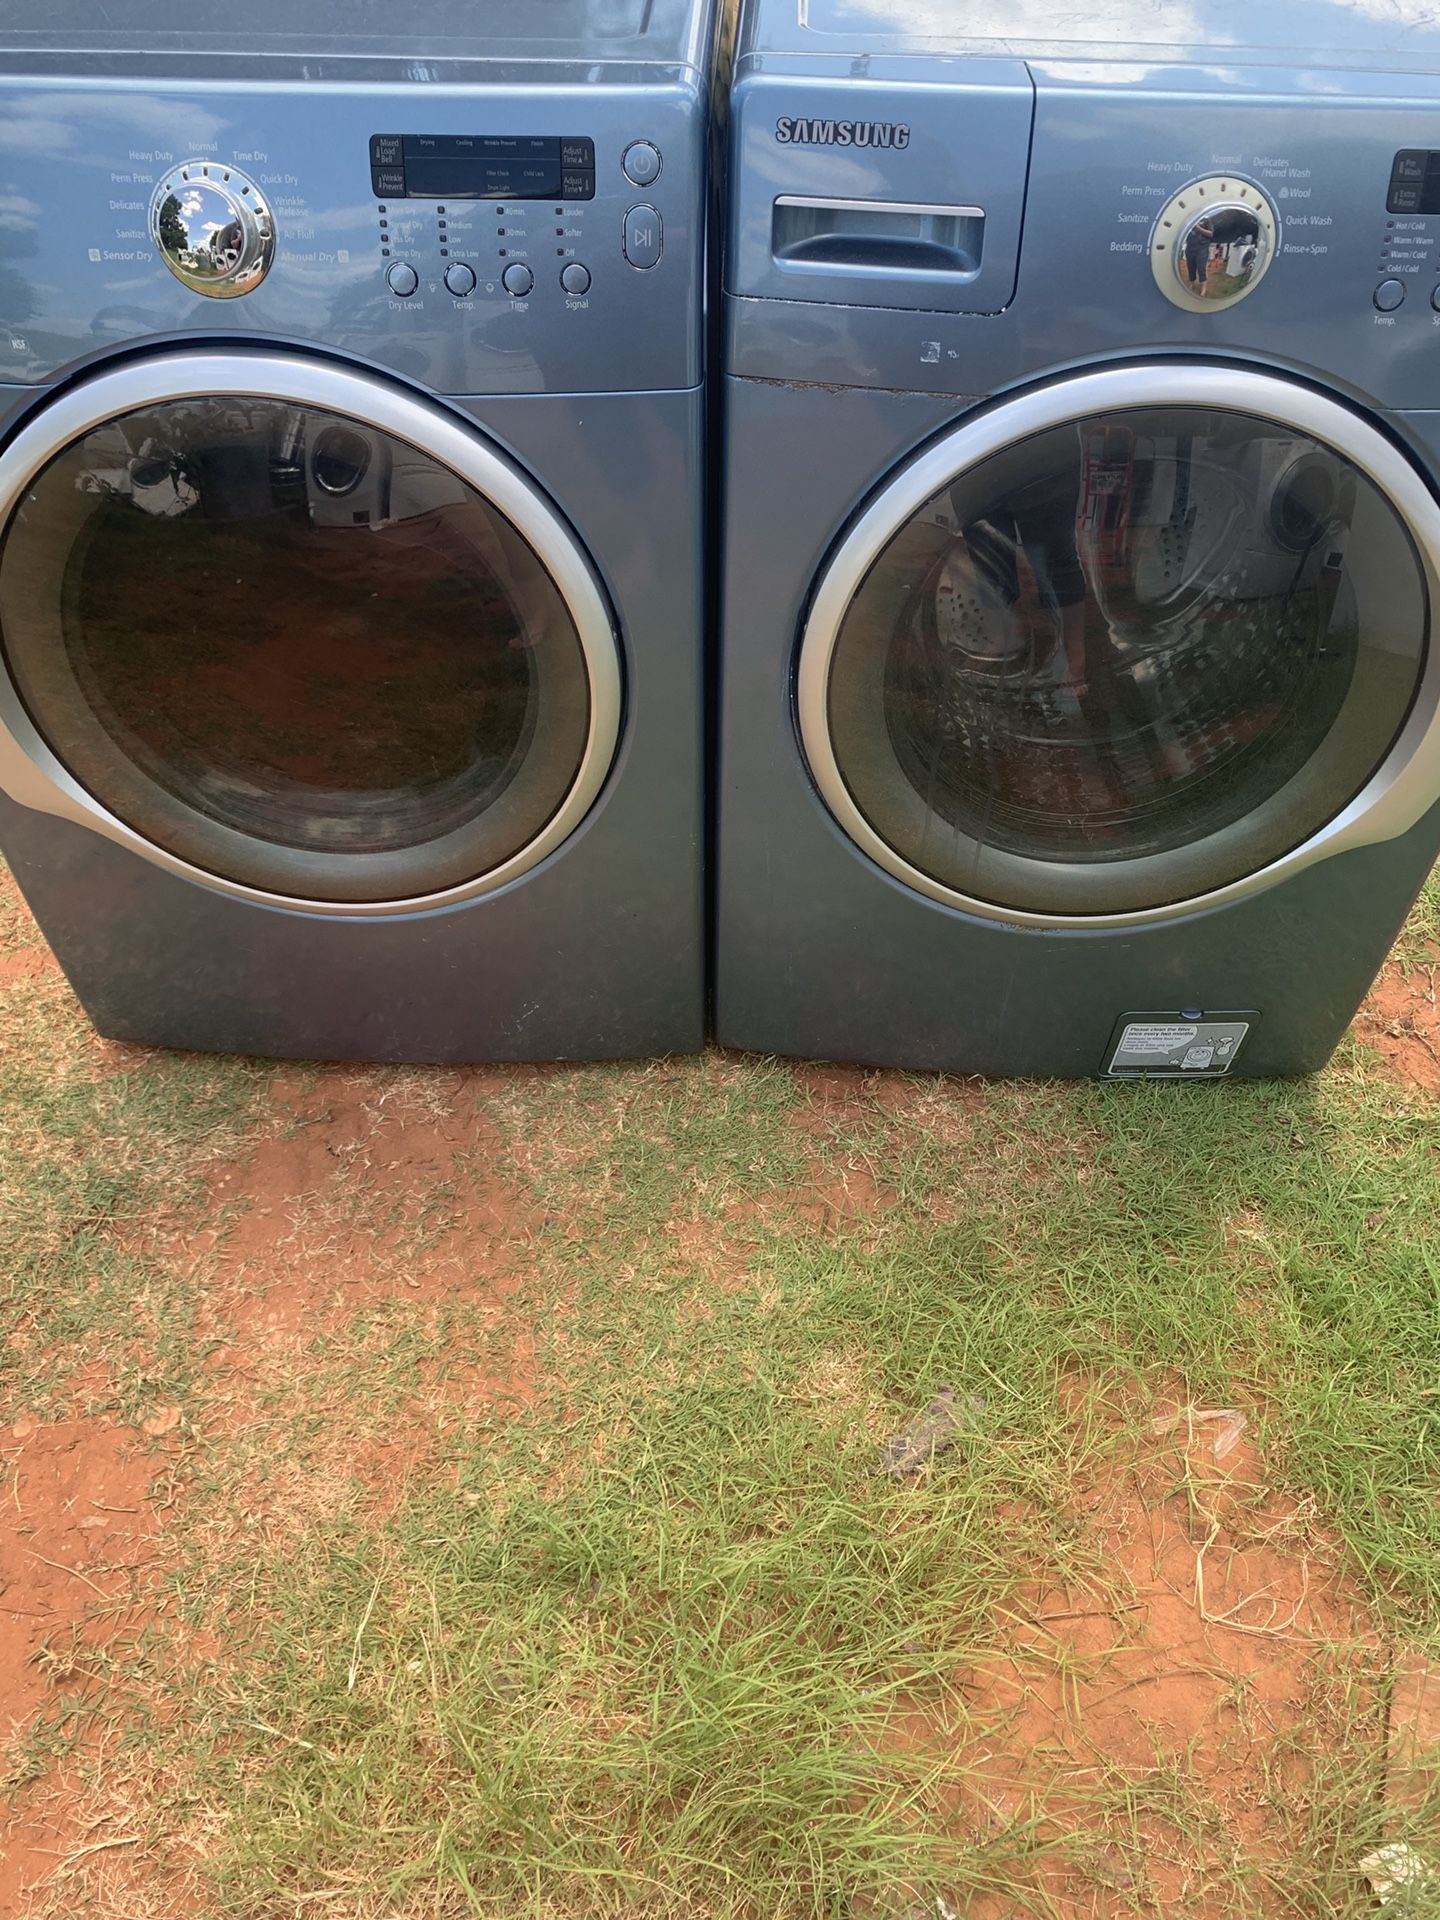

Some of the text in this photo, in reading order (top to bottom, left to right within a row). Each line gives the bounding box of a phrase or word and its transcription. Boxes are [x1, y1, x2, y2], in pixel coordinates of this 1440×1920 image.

[776, 116, 910, 149] SAMSUNG
[189, 142, 217, 151] Normal
[380, 138, 399, 147] Mixed
[129, 150, 173, 162] Heavy Duty
[381, 147, 396, 155] Load
[563, 146, 582, 156] Adjust
[233, 151, 268, 163] Time Dry
[563, 155, 577, 163] Time
[1212, 154, 1242, 164] Normal
[1253, 156, 1289, 167] Delicates
[1147, 161, 1194, 174] Heavy Duty
[1261, 167, 1311, 178] /Hand Wash
[111, 173, 153, 183] Perm Press
[260, 174, 299, 186] Quick Dry
[382, 174, 403, 182] Wrinkle
[563, 176, 582, 186] Adjust
[382, 182, 403, 191] Prevent
[564, 185, 578, 193] Time
[1121, 185, 1166, 196] Perm Press
[1290, 188, 1312, 198] Wool
[109, 200, 145, 210] Delicates
[274, 196, 304, 206] Wrinkle
[280, 207, 309, 217] Release
[563, 208, 584, 216] Louder
[1118, 213, 1149, 223] Sanitize
[1285, 215, 1333, 226] Quick Wash
[1396, 222, 1425, 231] Hot/Cold
[116, 229, 146, 239] Sanitize
[284, 230, 315, 239] Air Fluff
[564, 229, 582, 237] Softer
[448, 236, 462, 244] Low
[565, 248, 575, 257] Off
[1110, 241, 1143, 254] Bedding
[1283, 243, 1328, 255] Rinse+Spin
[103, 250, 153, 263] Sensor Dry
[281, 251, 335, 263] Manual Dry
[449, 249, 479, 258] Extra Low
[1390, 250, 1427, 259] Warm/Cold
[1387, 264, 1420, 273] Cold/Cold
[388, 300, 424, 311] Dry Level
[452, 300, 476, 311] Temp.
[510, 300, 529, 310] Time
[565, 299, 589, 311] Signal
[1373, 315, 1396, 327] Temp.
[12, 339, 26, 350] NSF
